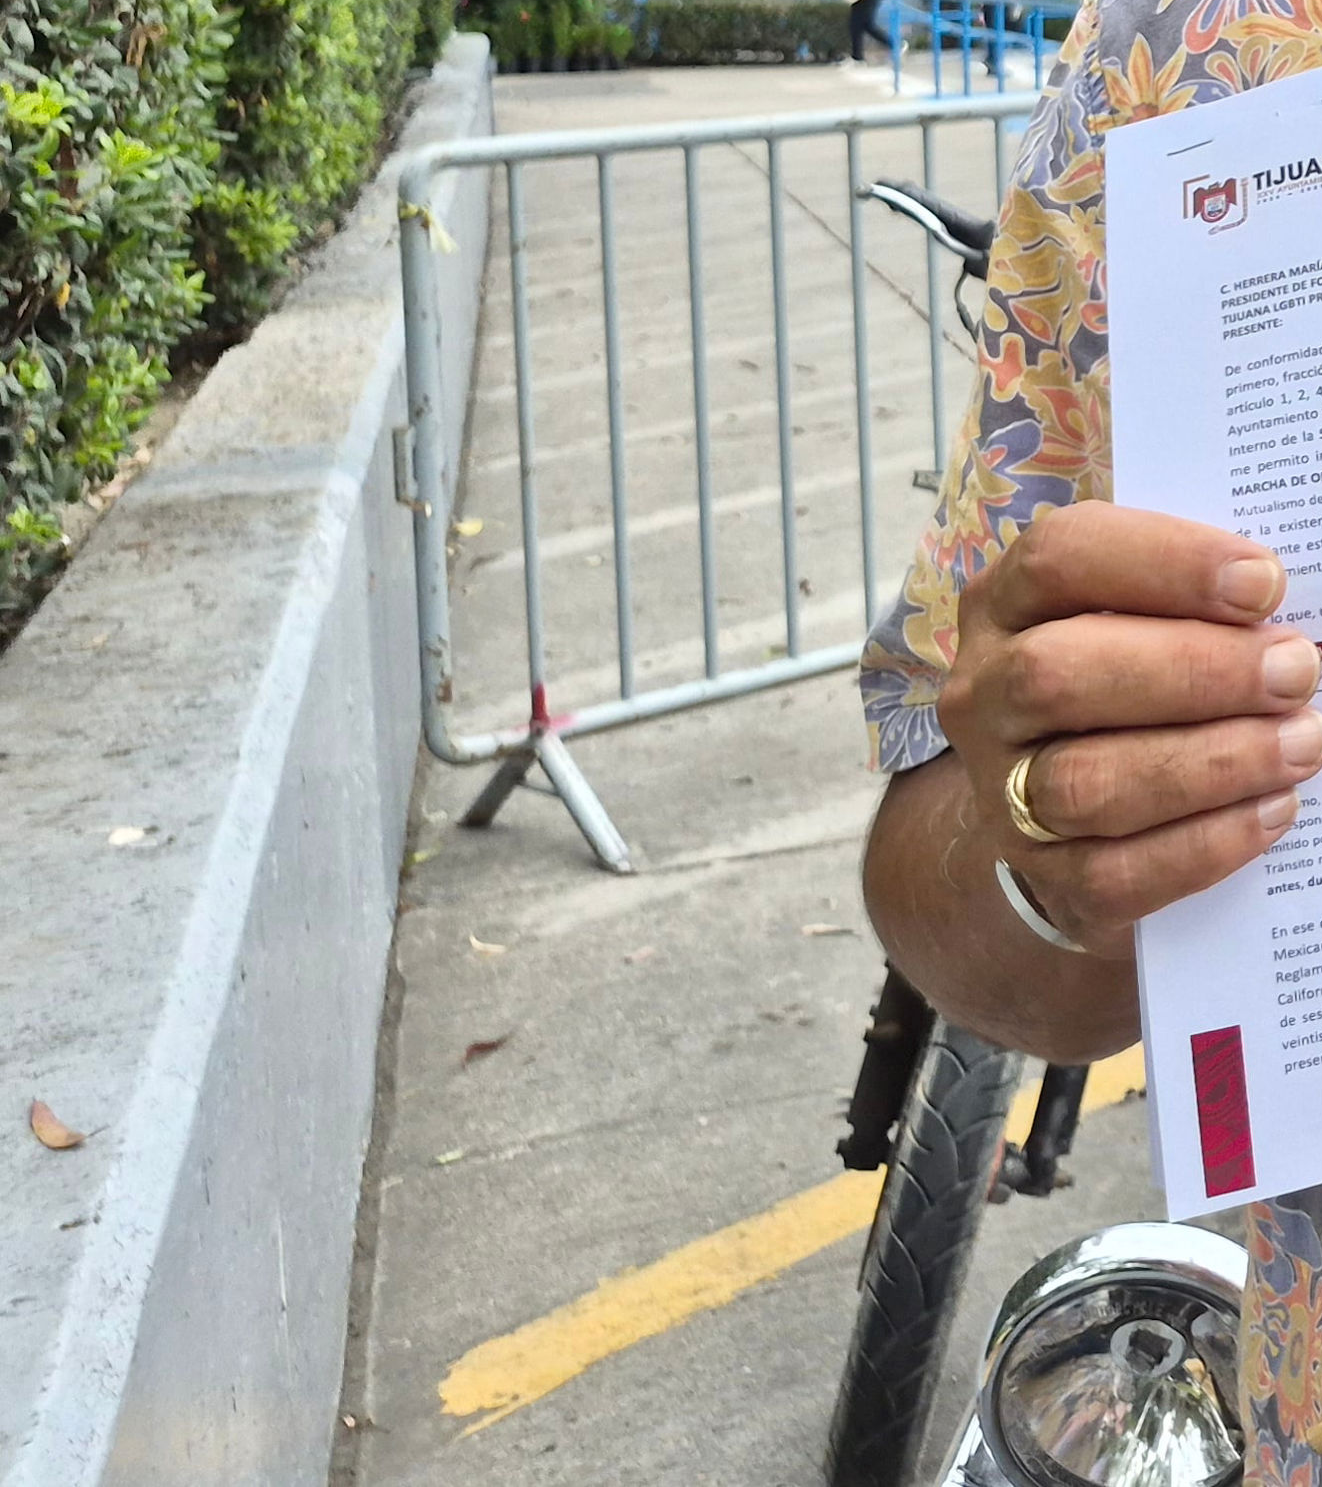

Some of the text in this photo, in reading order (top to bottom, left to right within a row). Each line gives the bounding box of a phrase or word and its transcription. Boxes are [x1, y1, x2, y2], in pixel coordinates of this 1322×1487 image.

[1233, 270, 1287, 292] HERRERA
[1221, 284, 1289, 310] PRESIDENTE
[1291, 279, 1308, 293] DE
[1272, 296, 1306, 313] LGBTI
[1222, 317, 1283, 341] PRESENTE:
[1231, 477, 1288, 497] MARCHA
[1290, 474, 1308, 487] DE
[1271, 926, 1288, 940] En
[1292, 922, 1315, 935] ese
